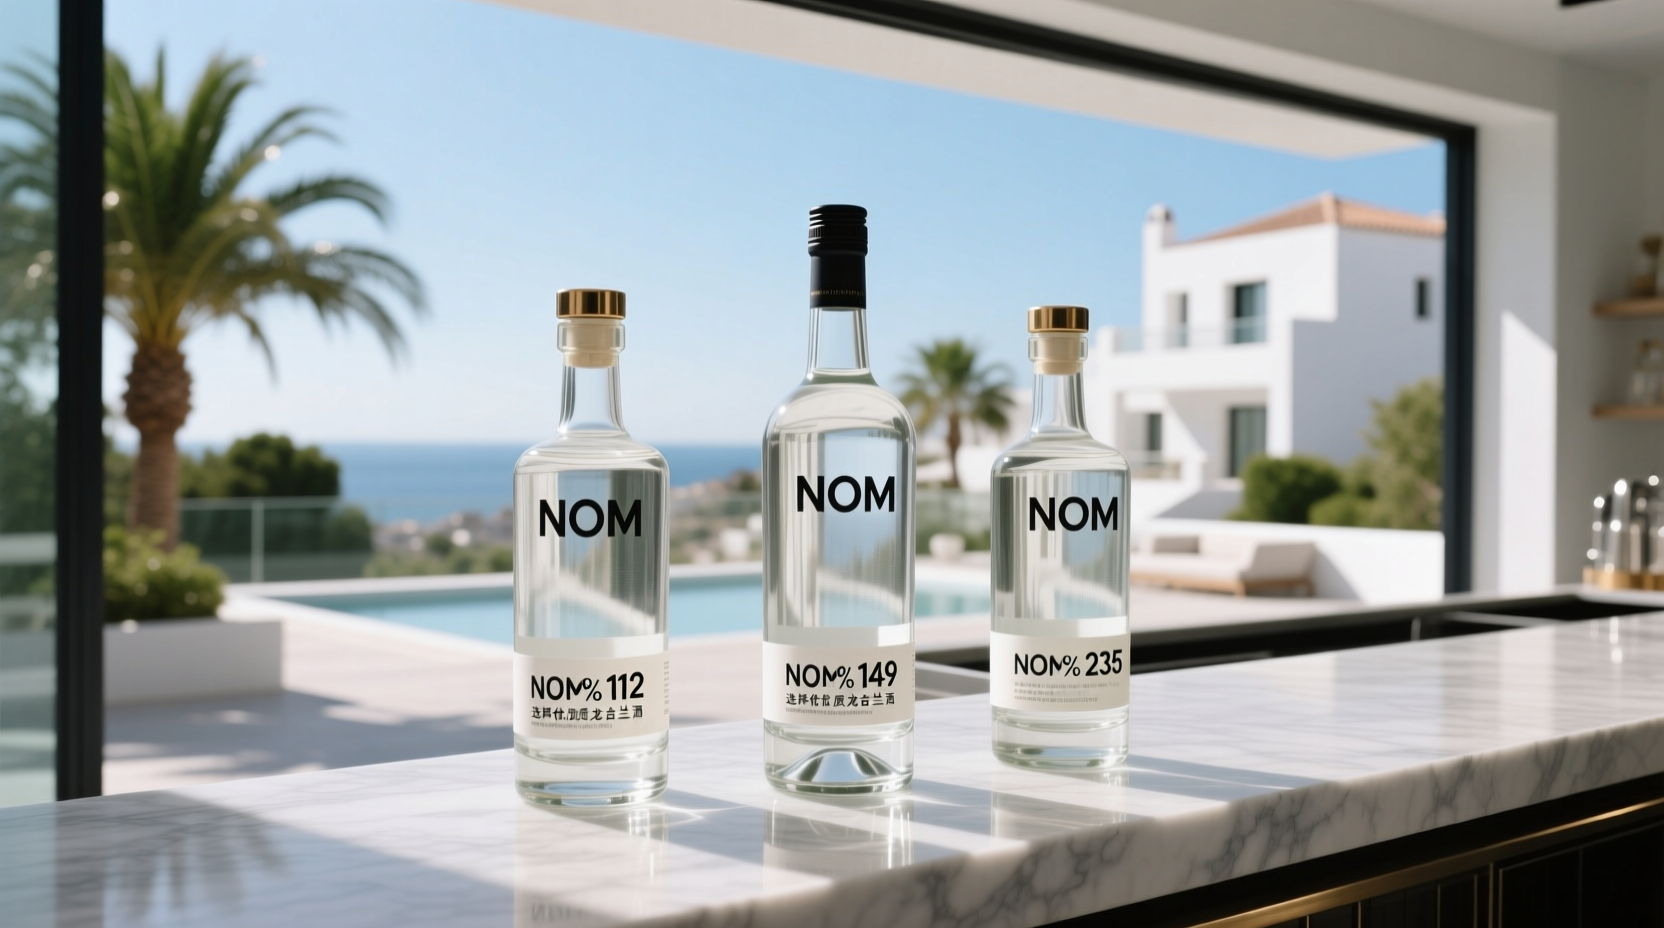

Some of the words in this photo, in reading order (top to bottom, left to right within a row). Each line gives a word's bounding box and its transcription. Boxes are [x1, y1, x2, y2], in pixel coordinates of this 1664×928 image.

[798, 476, 895, 512] NOM
[540, 499, 642, 537] NOM
[1030, 497, 1118, 531] NOM
[858, 660, 898, 688] 149
[1085, 649, 1123, 677] 235
[606, 671, 645, 701] 112
